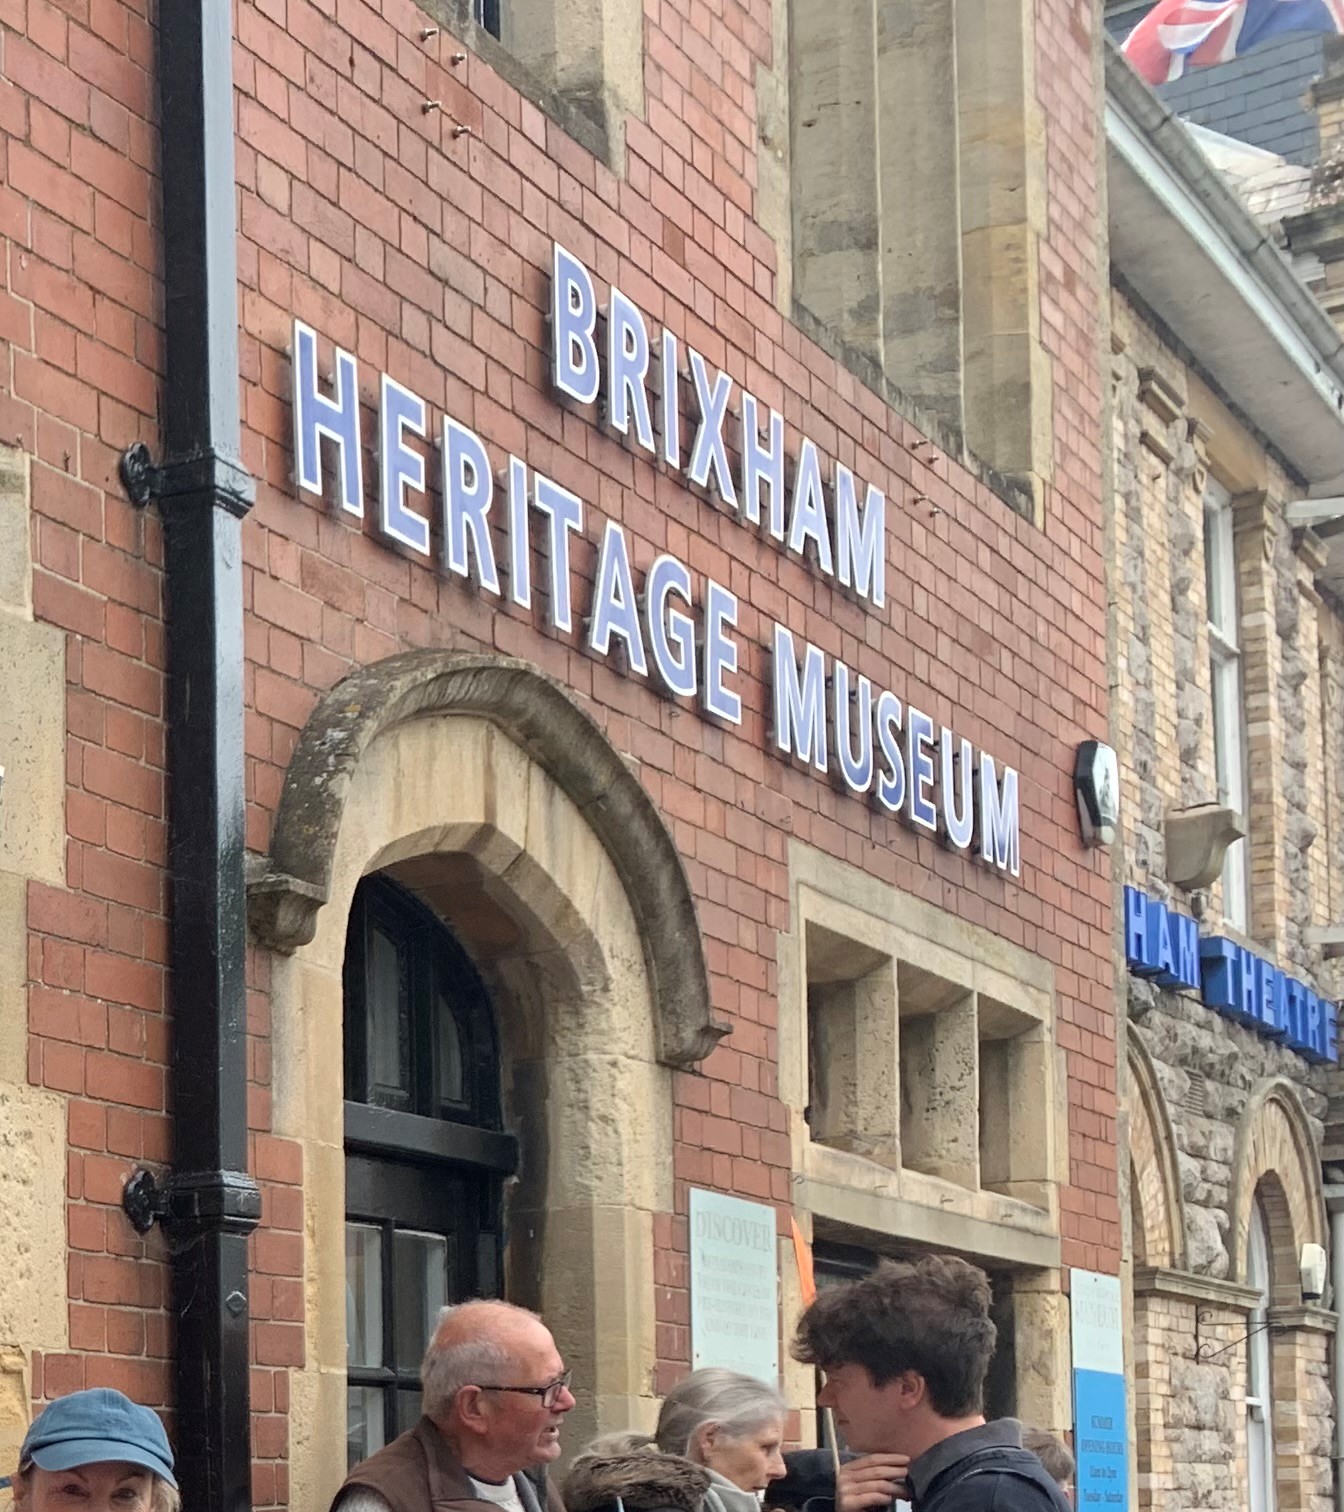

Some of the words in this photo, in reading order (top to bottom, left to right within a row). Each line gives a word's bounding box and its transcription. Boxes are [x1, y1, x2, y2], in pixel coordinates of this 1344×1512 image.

[552, 241, 887, 610] BRIXHAM
[293, 317, 743, 726] HERITAGE
[772, 622, 1021, 879] MUSEUM
[1204, 936, 1339, 1064] THEATRE
[696, 1211, 771, 1252] DISCOVER
